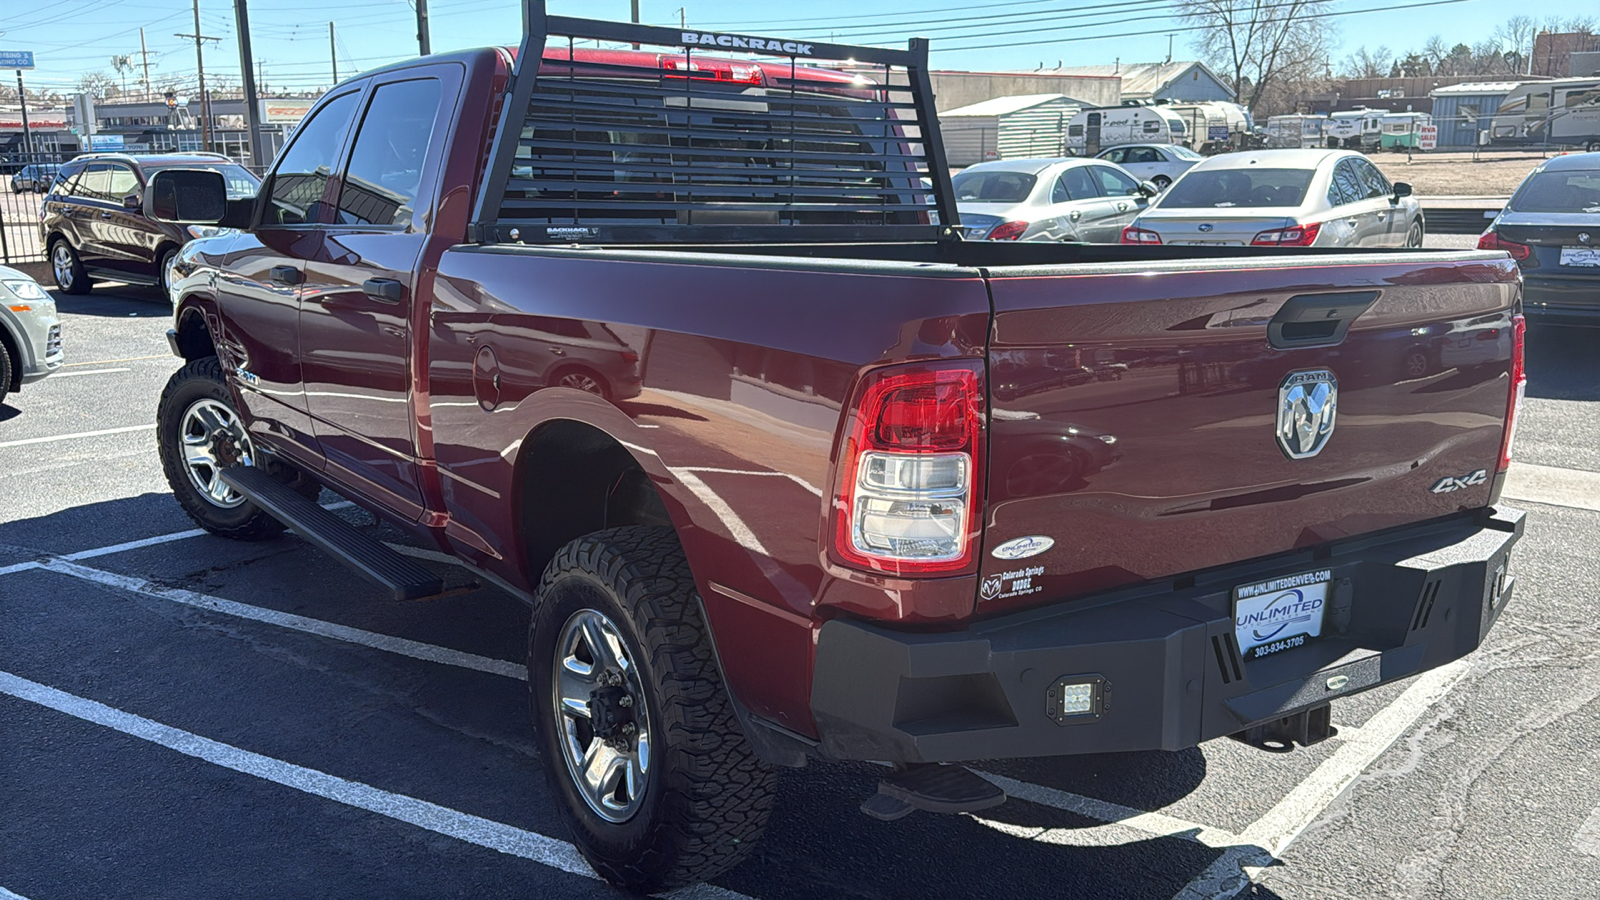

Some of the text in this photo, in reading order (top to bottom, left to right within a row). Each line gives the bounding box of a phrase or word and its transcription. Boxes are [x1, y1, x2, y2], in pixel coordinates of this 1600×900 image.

[681, 32, 812, 55] BACKRACK
[1294, 372, 1328, 383] RAM
[1431, 469, 1488, 494] 4x4
[1002, 541, 1042, 552] UNLIMITED
[1002, 566, 1044, 580] Colorado Springs
[1012, 578, 1032, 591] DODGE
[998, 591, 1018, 599] Colorado
[1236, 599, 1323, 626] UNLIMITED
[1254, 636, 1305, 658] 303-934-3705
